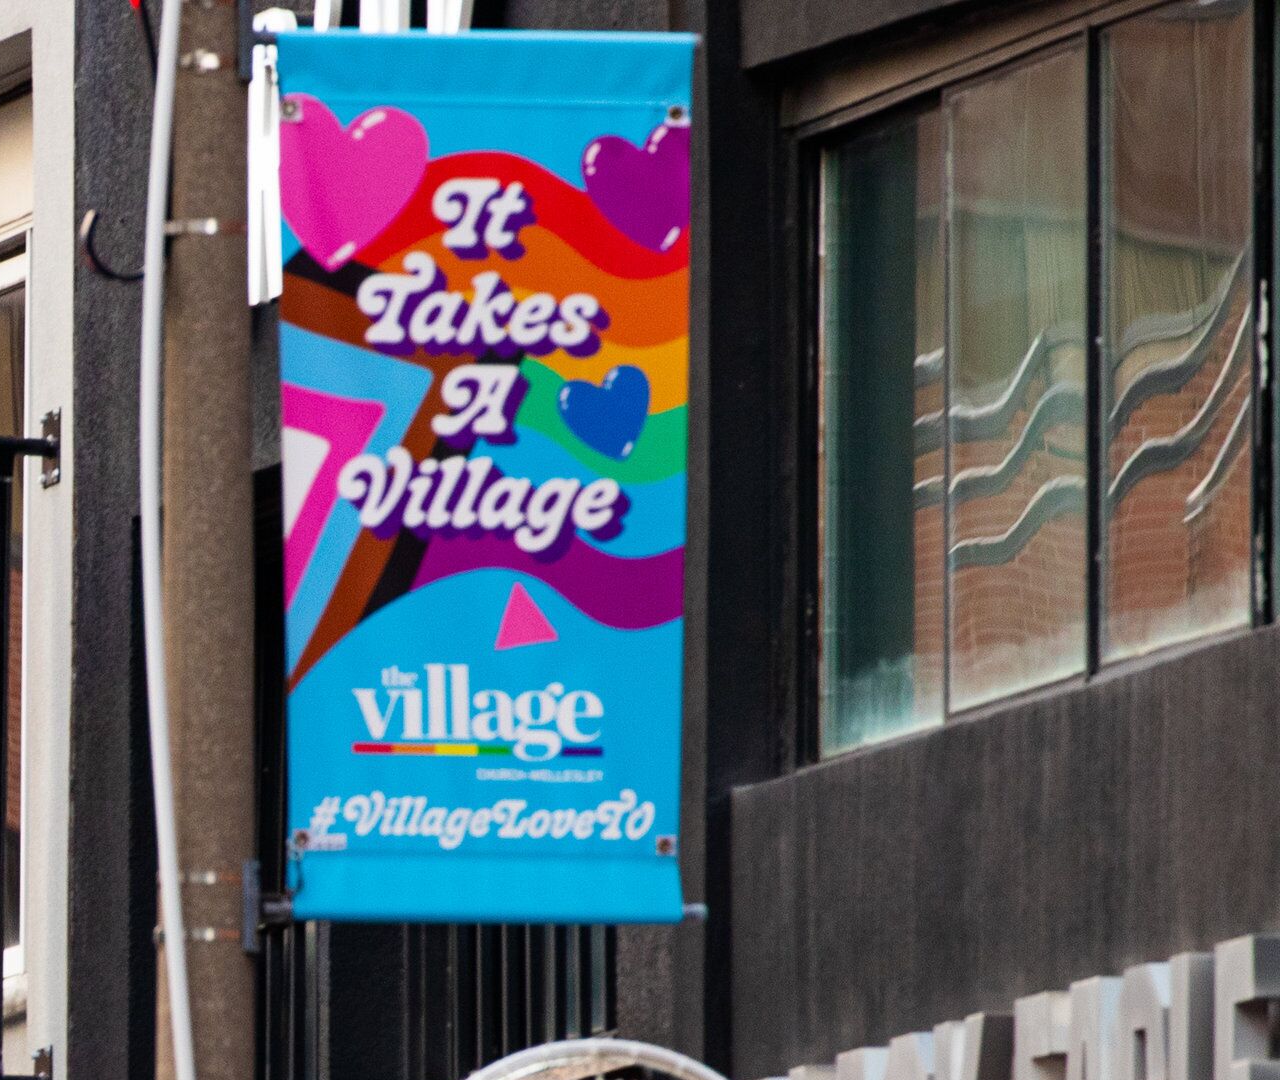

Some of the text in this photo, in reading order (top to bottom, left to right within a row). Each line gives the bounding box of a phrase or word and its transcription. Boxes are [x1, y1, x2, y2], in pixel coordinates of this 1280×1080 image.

[432, 177, 530, 252] It
[357, 251, 602, 350] Takes
[431, 363, 524, 438] A
[339, 445, 624, 553] Village
[351, 663, 605, 762] village
[381, 665, 419, 688] the
